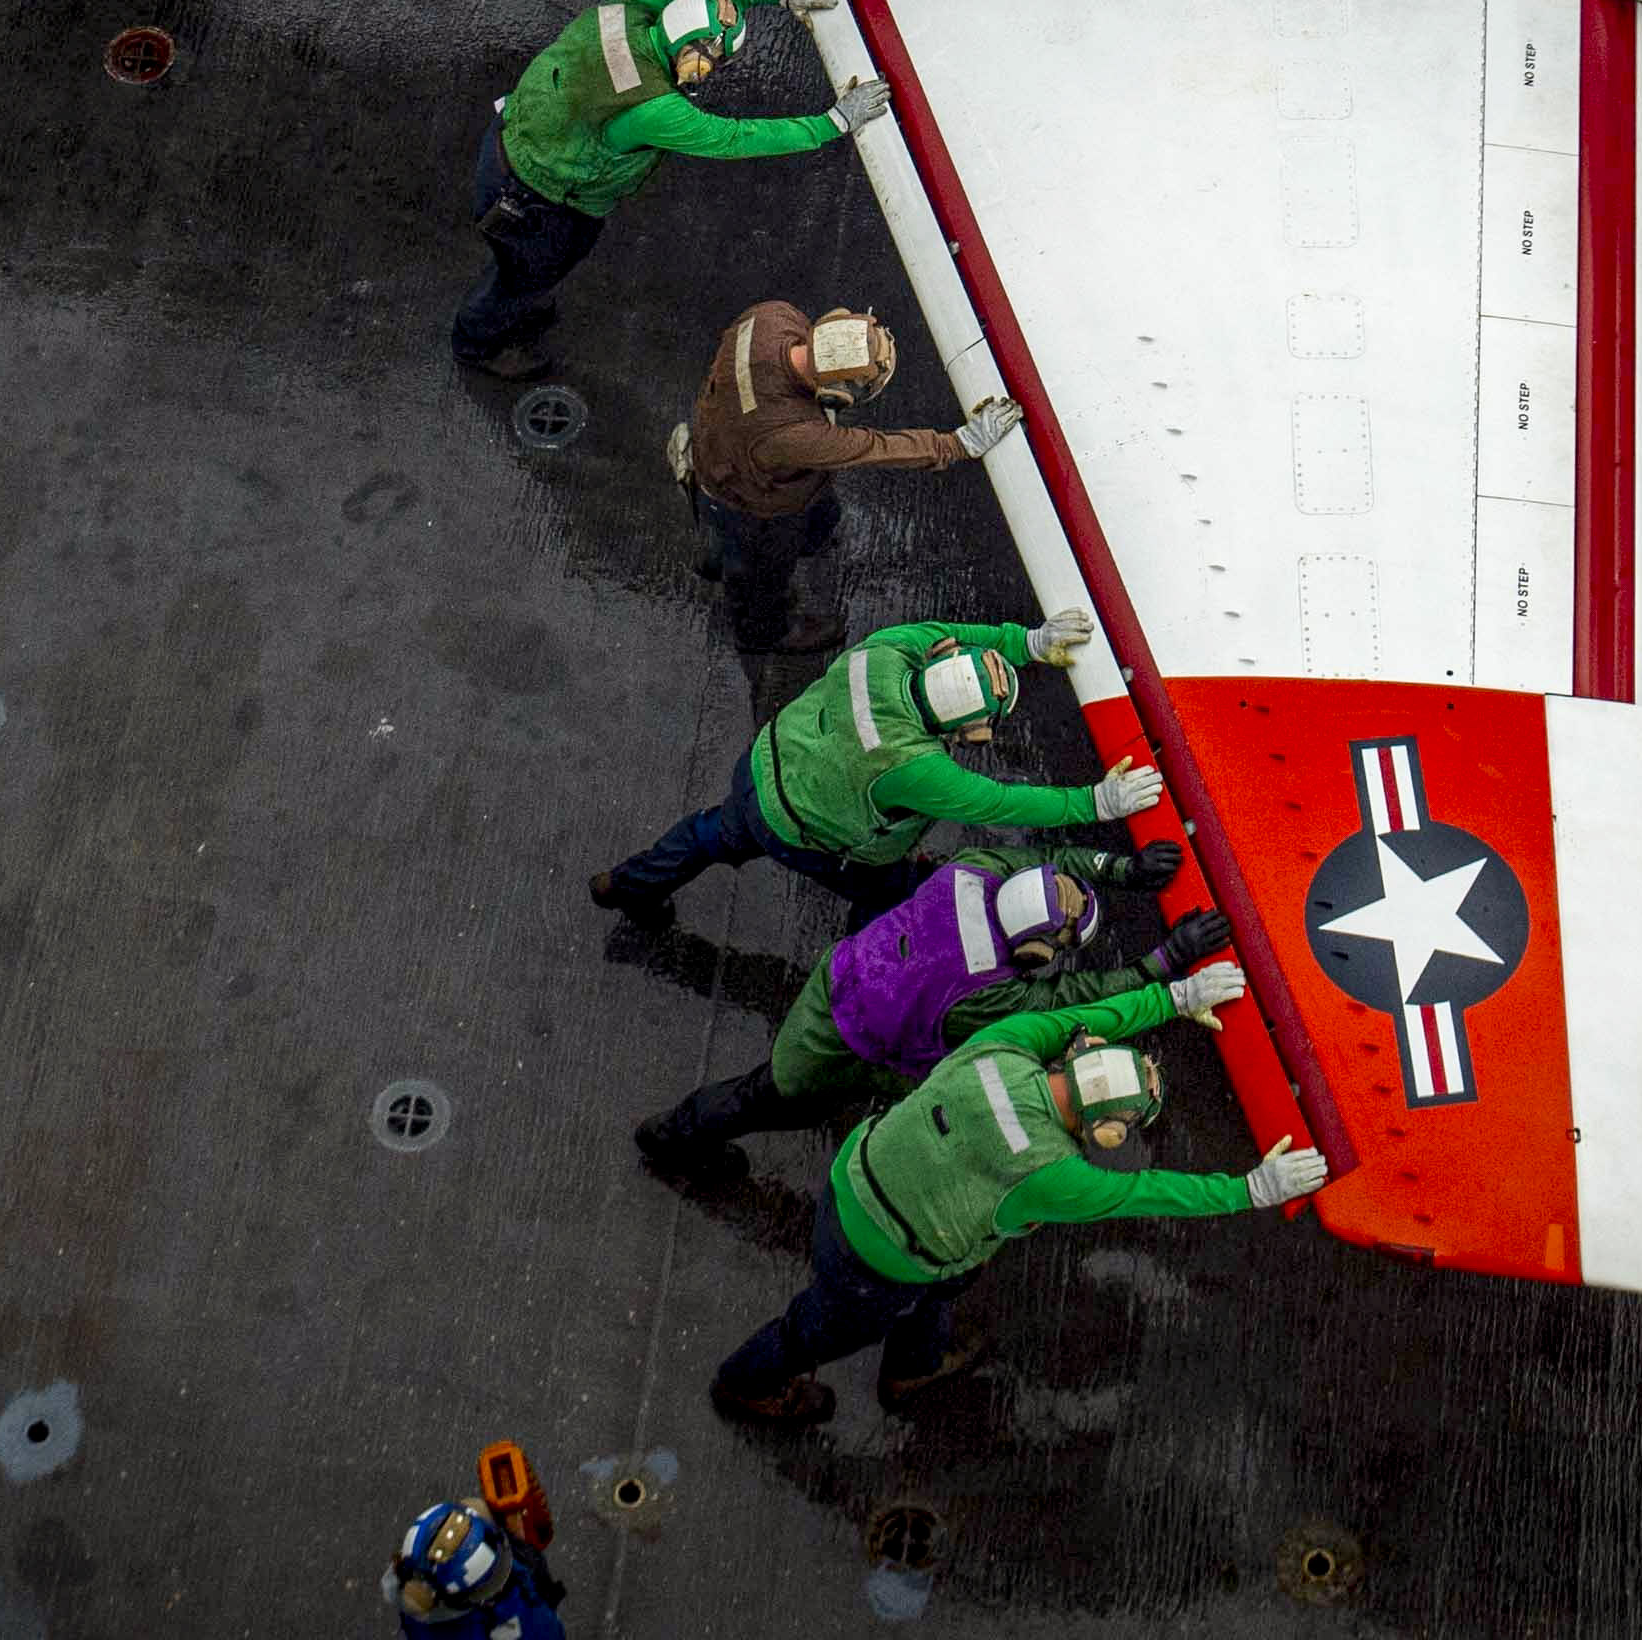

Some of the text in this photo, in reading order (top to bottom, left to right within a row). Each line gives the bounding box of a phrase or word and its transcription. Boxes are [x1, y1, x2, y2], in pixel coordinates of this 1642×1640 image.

[1524, 43, 1536, 87] NO STEP
[1522, 210, 1534, 255] NO STEP
[1518, 382, 1530, 430] NO STEP
[1517, 567, 1529, 617] NO STEP
